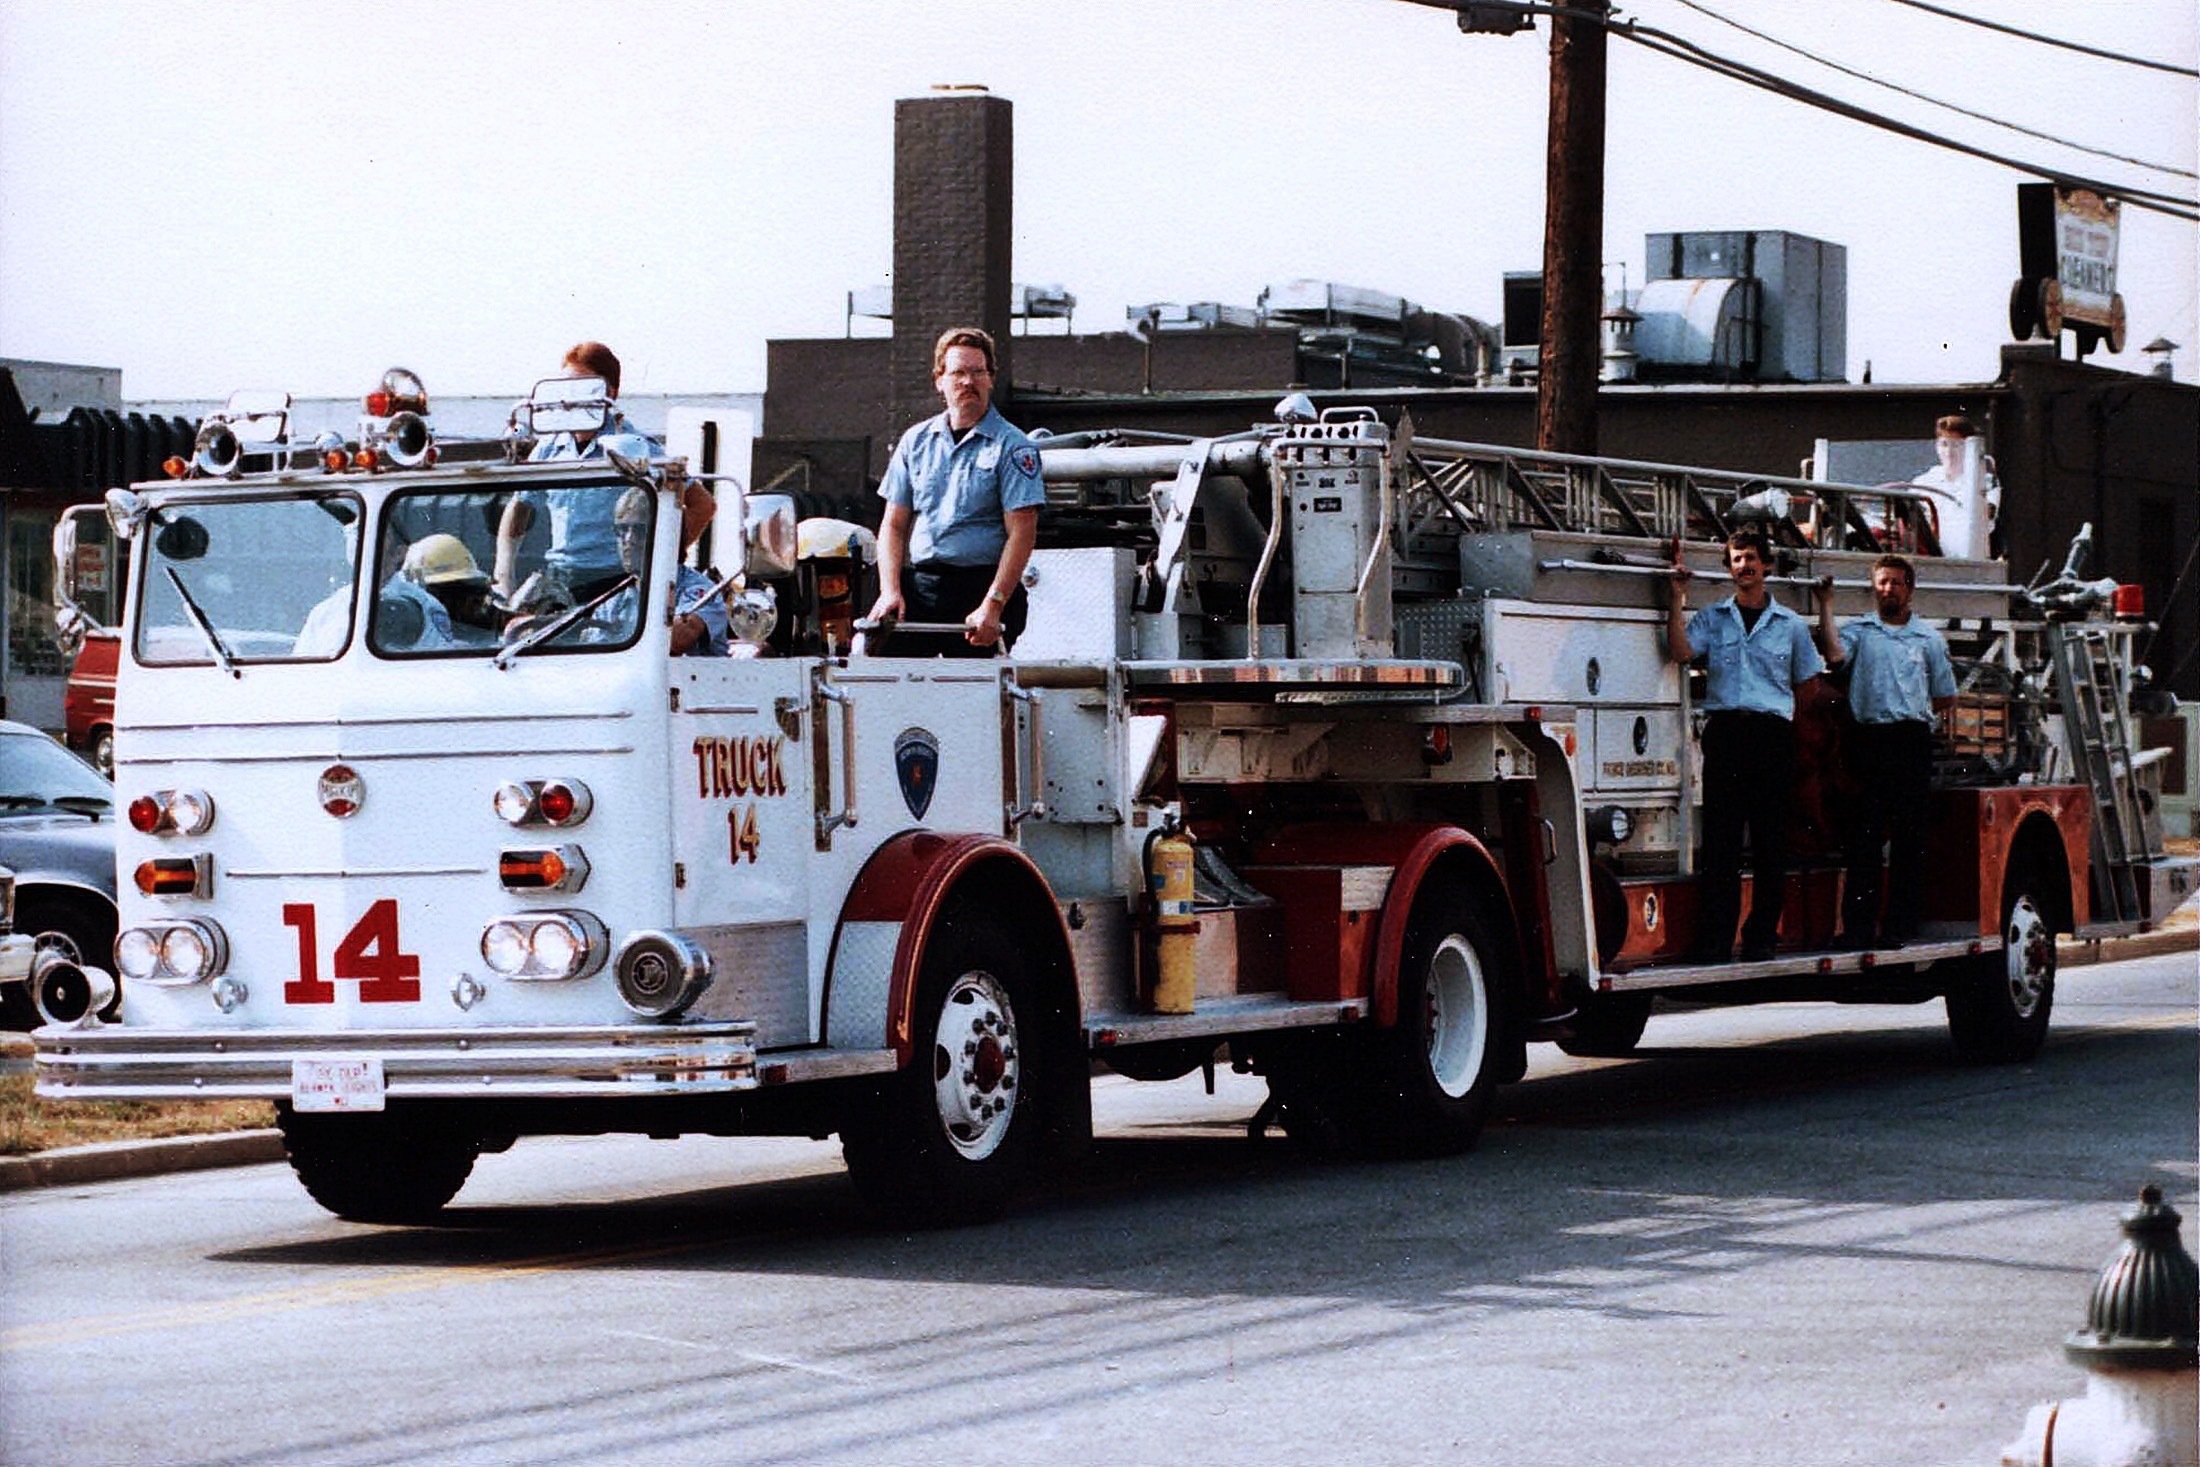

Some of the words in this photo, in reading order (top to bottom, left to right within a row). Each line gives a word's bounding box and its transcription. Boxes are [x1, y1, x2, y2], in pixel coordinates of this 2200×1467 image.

[693, 735, 786, 798] TRUCK
[728, 803, 760, 865] 14
[283, 899, 420, 1004] 14
